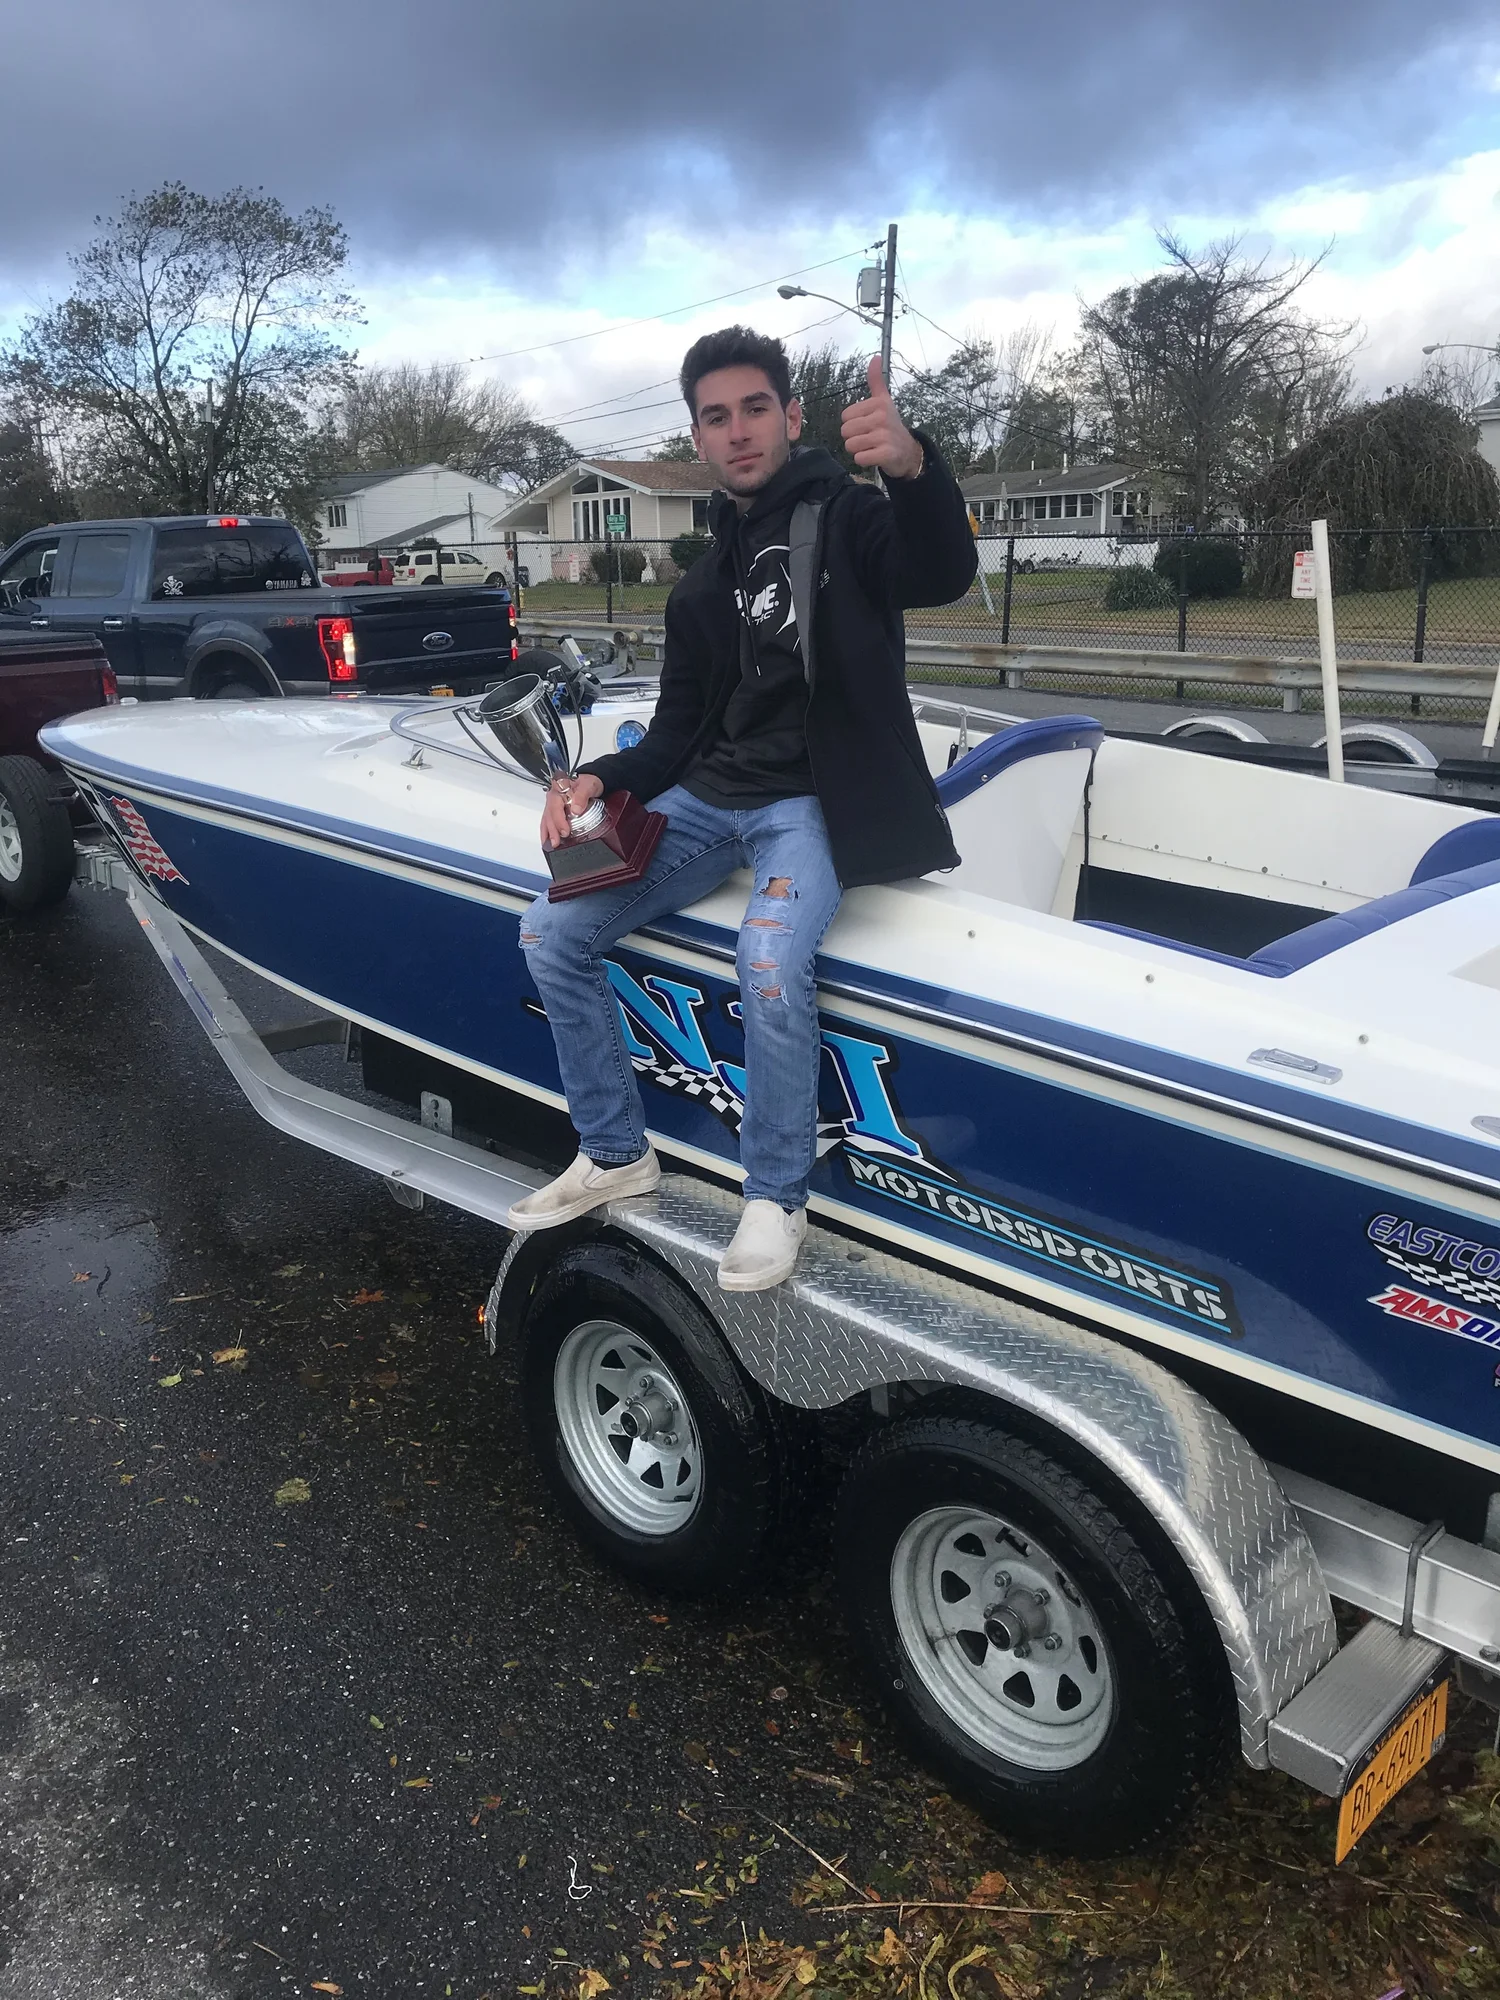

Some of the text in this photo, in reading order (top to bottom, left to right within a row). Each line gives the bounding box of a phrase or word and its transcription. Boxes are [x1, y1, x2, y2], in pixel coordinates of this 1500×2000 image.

[273, 579, 298, 589] YAMAHA
[430, 635, 447, 646] Ford
[602, 958, 924, 1159] NI
[847, 1153, 1228, 1321] MOTORSPORTS
[1367, 1213, 1500, 1280] EASTCO
[1376, 1287, 1500, 1346] AMSOI
